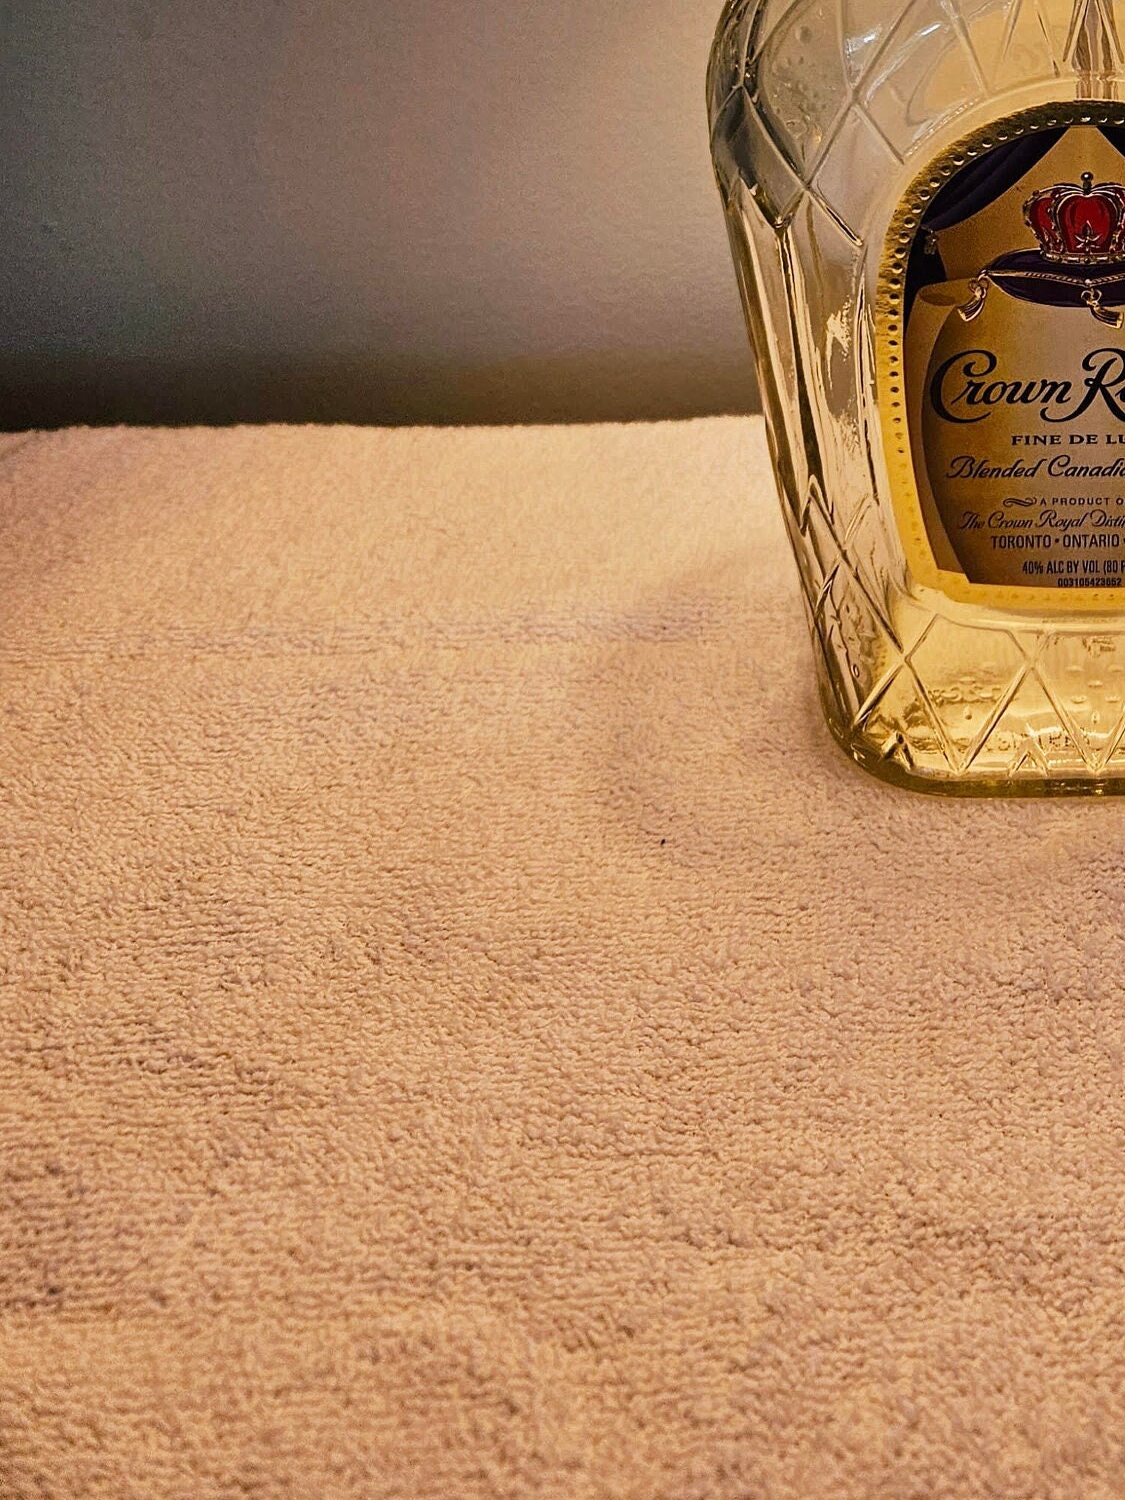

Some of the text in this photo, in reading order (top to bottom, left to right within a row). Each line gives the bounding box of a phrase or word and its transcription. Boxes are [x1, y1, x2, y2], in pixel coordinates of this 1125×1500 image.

[930, 349, 1073, 423] Crown
[1011, 434, 1062, 446] FINE
[1069, 434, 1098, 445] DE
[946, 455, 1048, 479] Blended
[1040, 498, 1047, 506] A
[1052, 497, 1110, 506] PRODUCT
[960, 510, 986, 530] The
[987, 510, 1034, 529] Crown
[1035, 509, 1091, 532] Royal
[991, 534, 1052, 549] TORONTO
[1063, 533, 1120, 548] ONTARIO
[1022, 561, 1044, 574] 40%
[1046, 560, 1064, 574] ALC
[1067, 560, 1080, 573] BY
[1082, 560, 1100, 574] VOL
[1103, 560, 1118, 575] (80
